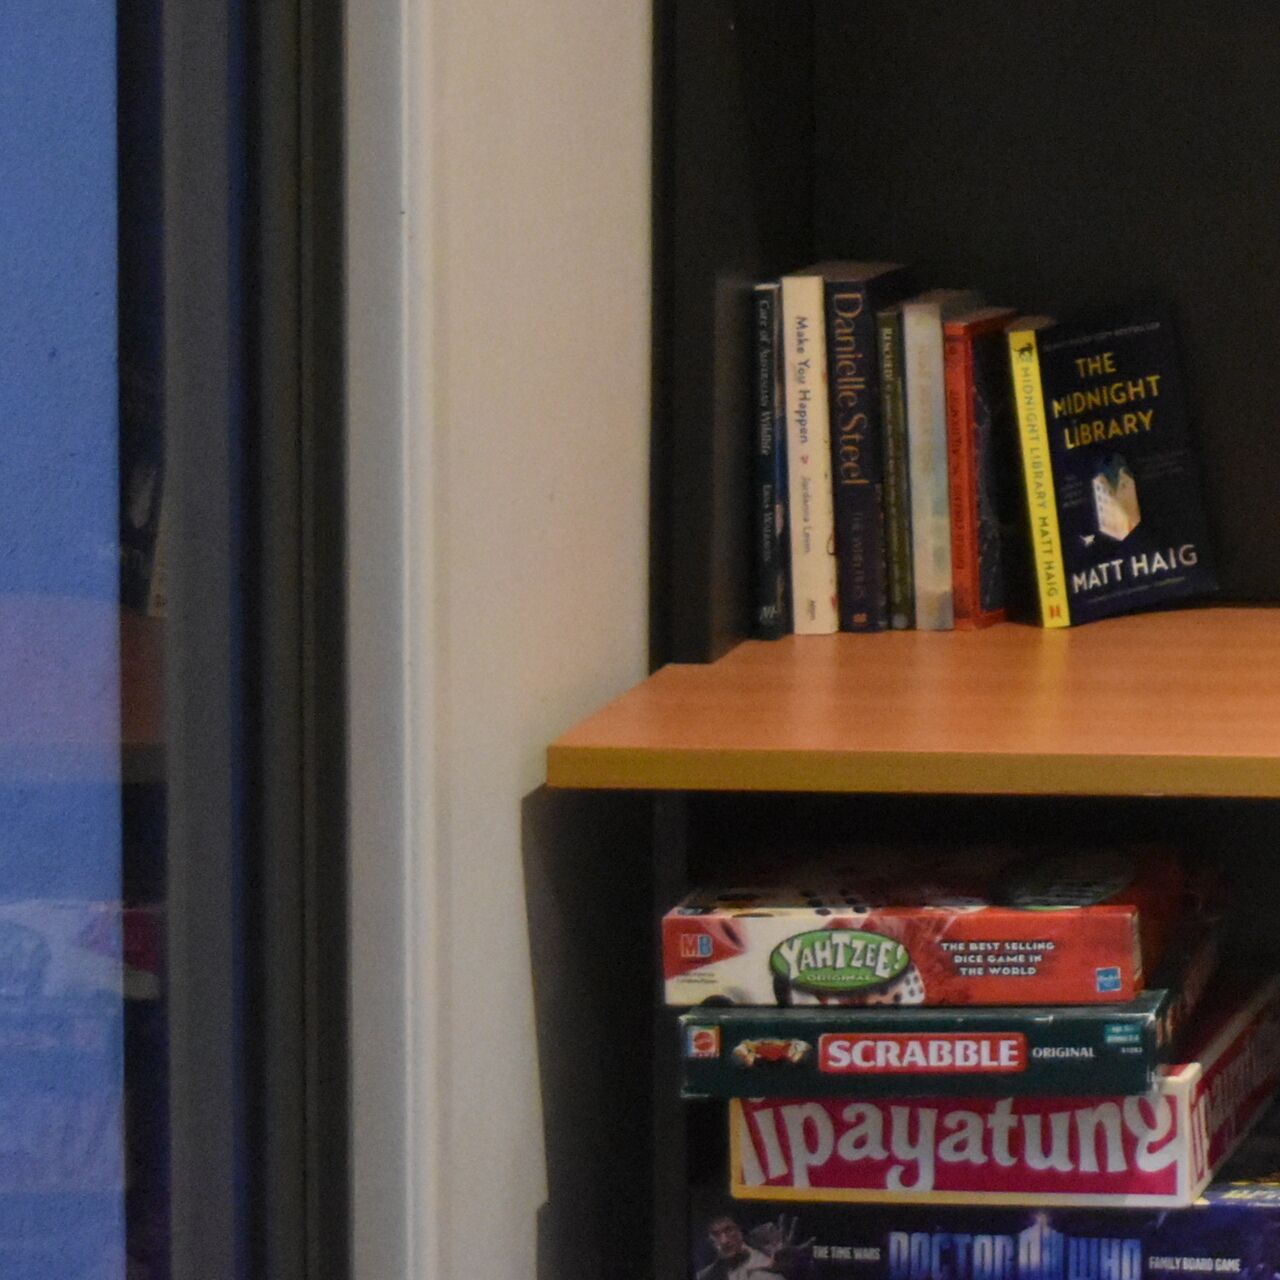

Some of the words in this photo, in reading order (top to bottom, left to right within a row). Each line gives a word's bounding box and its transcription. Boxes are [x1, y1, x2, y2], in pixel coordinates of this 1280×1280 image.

[795, 316, 808, 354] Make
[831, 292, 868, 408] Danielle
[796, 359, 810, 384] You
[1076, 351, 1118, 379] THE
[1019, 366, 1039, 442] MIDNIGHT
[1051, 374, 1161, 420] MIDNIGHT
[797, 389, 813, 444] Happen
[1063, 408, 1156, 450] LIBRARY
[838, 412, 869, 485] Steel
[1028, 447, 1046, 509] LIBRARY
[1036, 516, 1052, 555] MATT
[1042, 559, 1058, 597] HAIG
[1071, 557, 1123, 595] MATT
[1131, 544, 1199, 578] HAIG
[681, 933, 713, 958] MB
[782, 933, 907, 978] YAHTZEE!
[941, 941, 963, 952] THE
[967, 941, 1000, 952] BEST
[1004, 941, 1055, 952] SELLING
[953, 954, 982, 965] DICE
[985, 954, 1024, 965] GAME
[1027, 954, 1042, 964] IN
[959, 967, 985, 977] THE
[989, 966, 1037, 977] WORLD
[826, 1039, 1020, 1068] SCRABBLE
[1032, 1047, 1096, 1059] ORIGINAL
[813, 1246, 830, 1261] THE
[832, 1247, 853, 1261] TIME
[854, 1247, 882, 1262] WARS
[888, 1232, 1015, 1280] DOCTOR
[1070, 1236, 1143, 1280] WHO
[1148, 1256, 1180, 1272] FAMILY
[1180, 1257, 1210, 1272] BOARD
[1211, 1257, 1242, 1273] GAME
